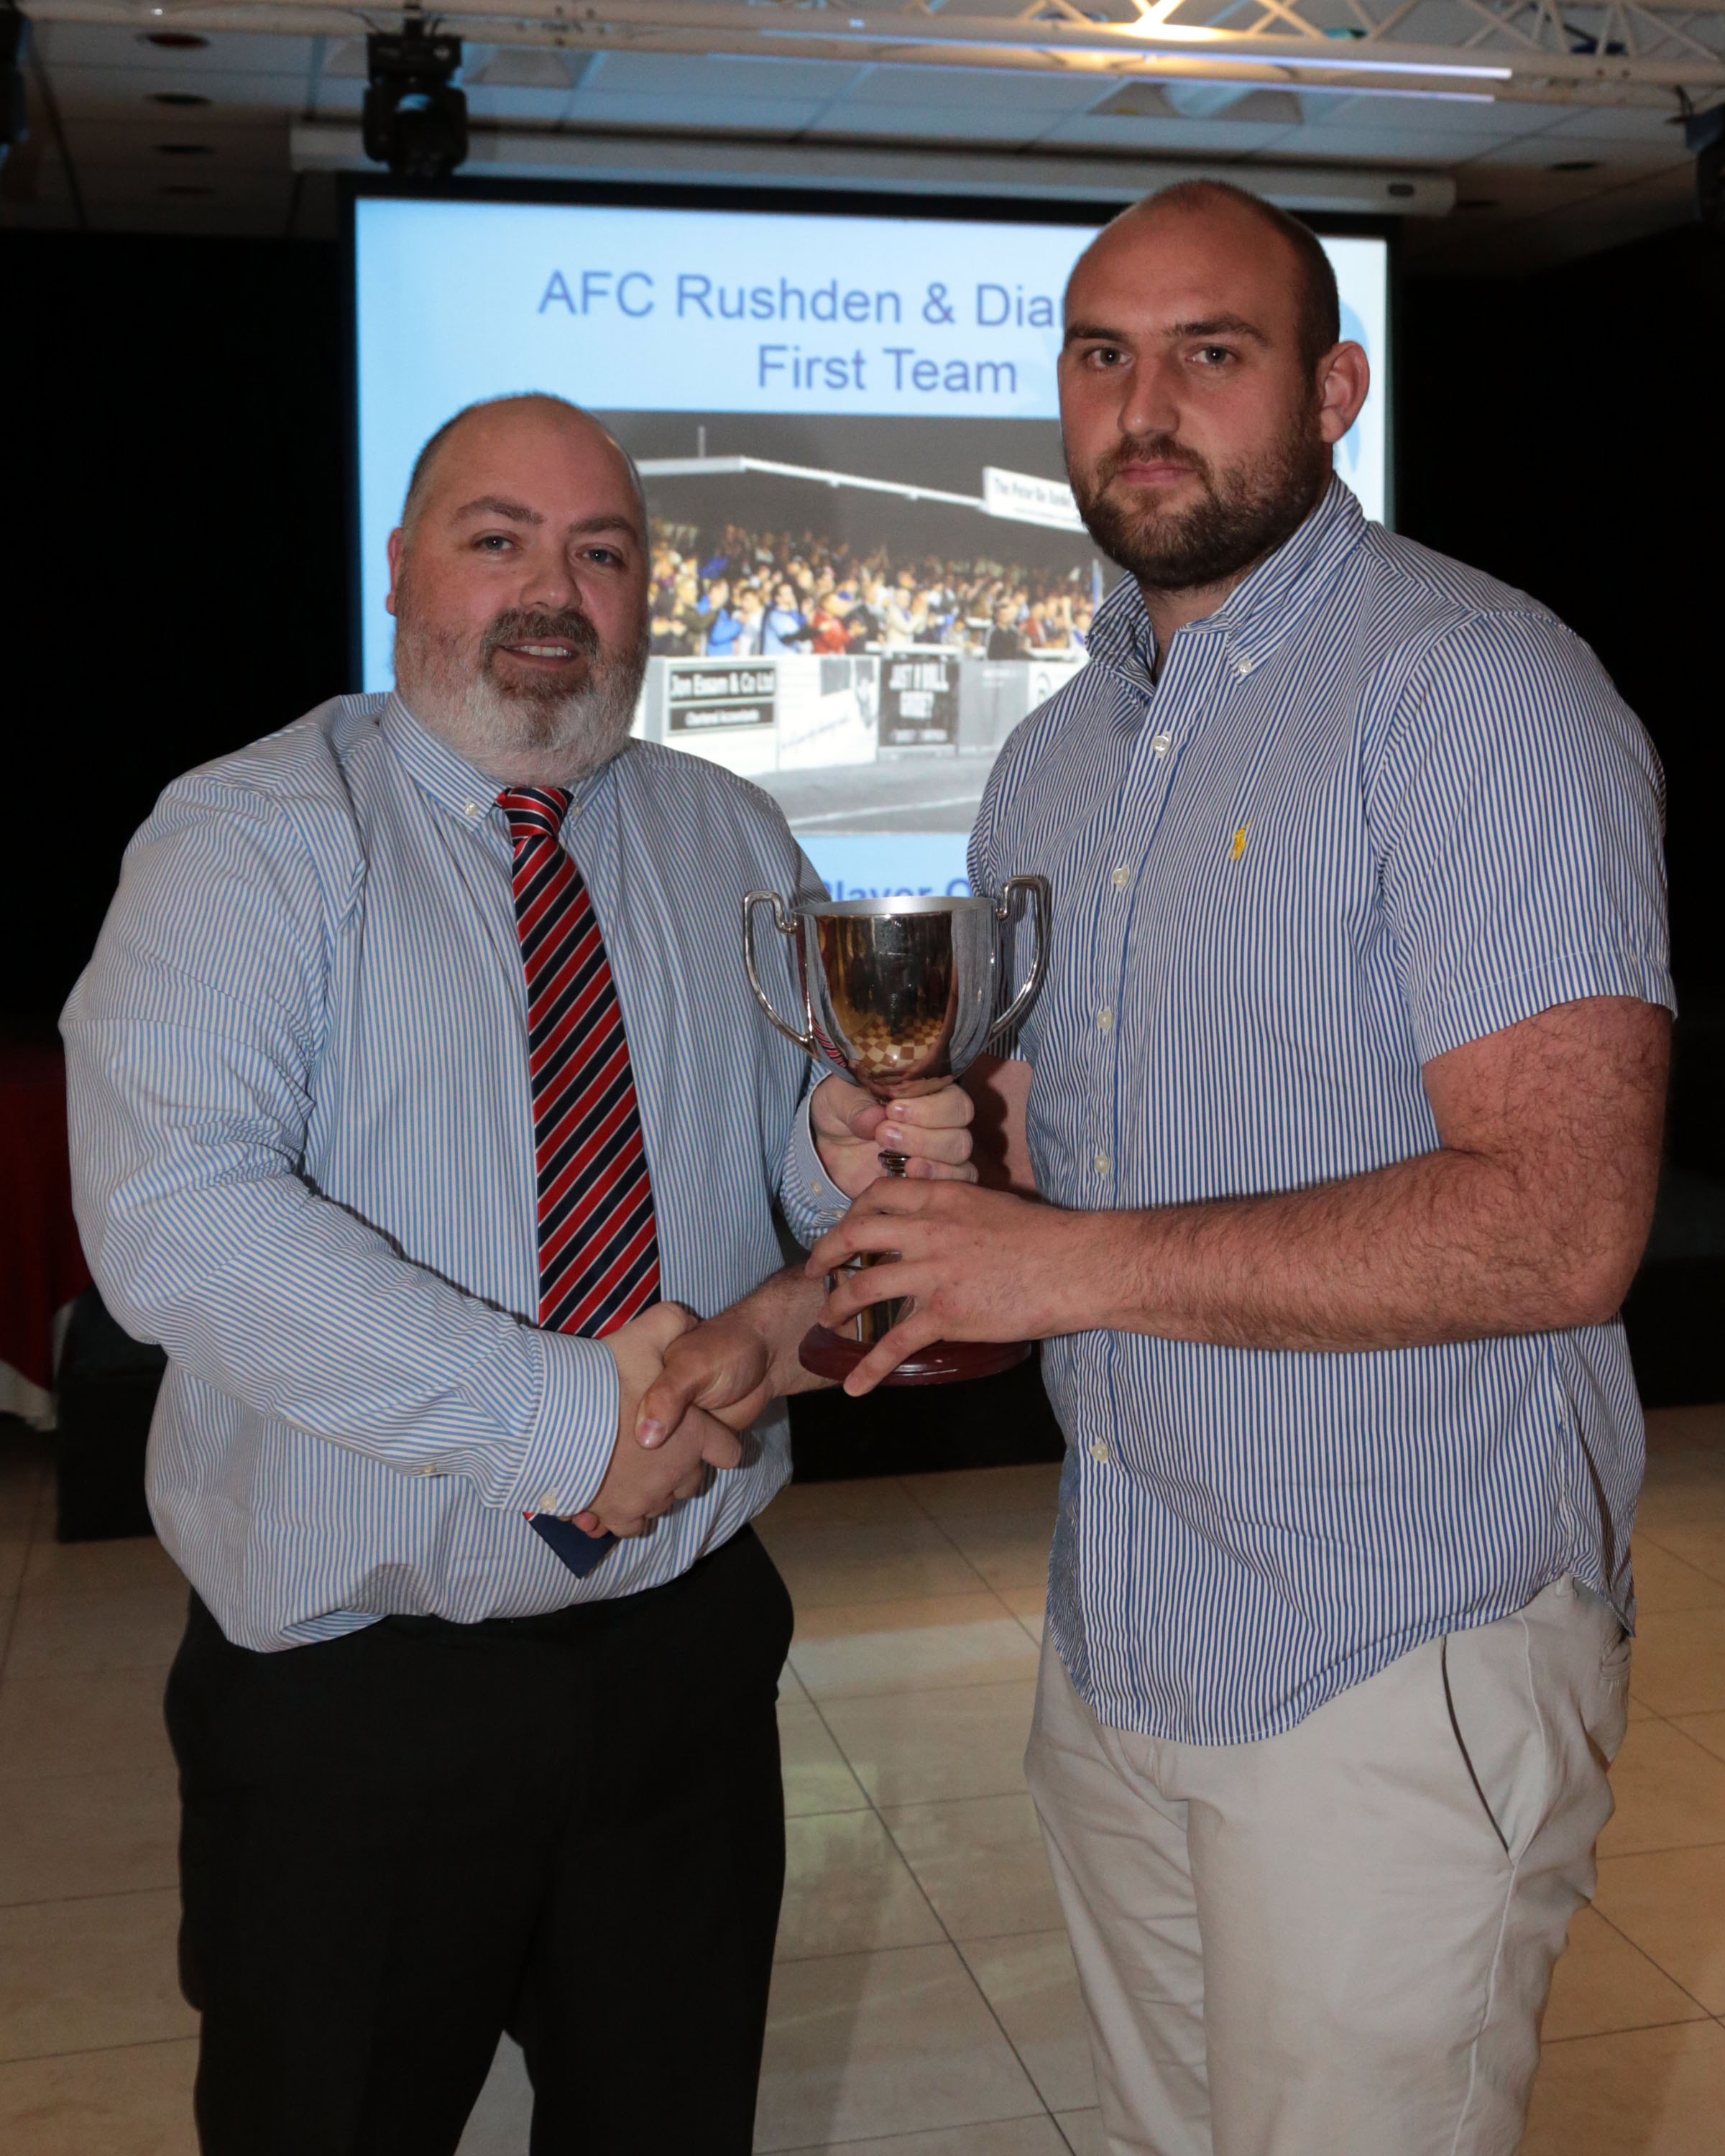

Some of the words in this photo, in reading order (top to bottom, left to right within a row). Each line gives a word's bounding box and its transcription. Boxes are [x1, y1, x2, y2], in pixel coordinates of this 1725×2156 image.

[538, 270, 655, 318] AFC
[676, 273, 901, 323] Rushden
[921, 282, 955, 325] &
[976, 282, 1054, 328] Dia
[758, 344, 866, 390] First
[882, 347, 1016, 393] Team
